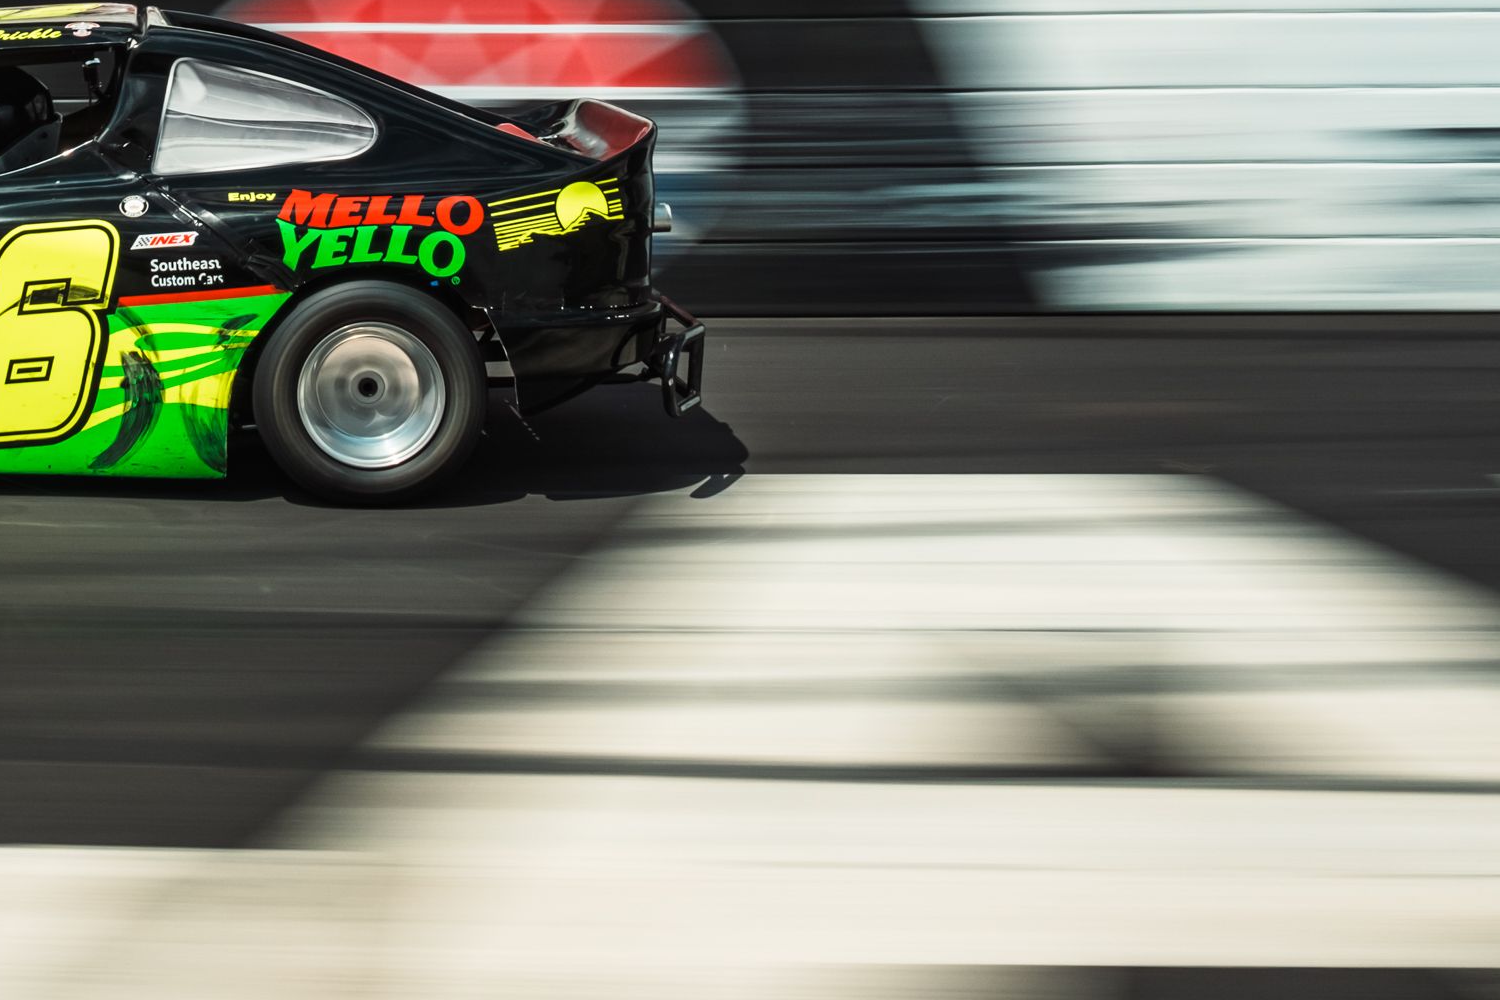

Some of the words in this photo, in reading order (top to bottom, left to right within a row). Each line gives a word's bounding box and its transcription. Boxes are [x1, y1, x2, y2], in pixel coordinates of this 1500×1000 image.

[228, 192, 276, 202] Enjoy
[277, 189, 484, 235] MELLO
[149, 233, 195, 247] INEX
[276, 218, 466, 277] YELLO
[150, 257, 222, 272] Southeast
[151, 274, 196, 287] Custom
[199, 273, 224, 285] Cars
